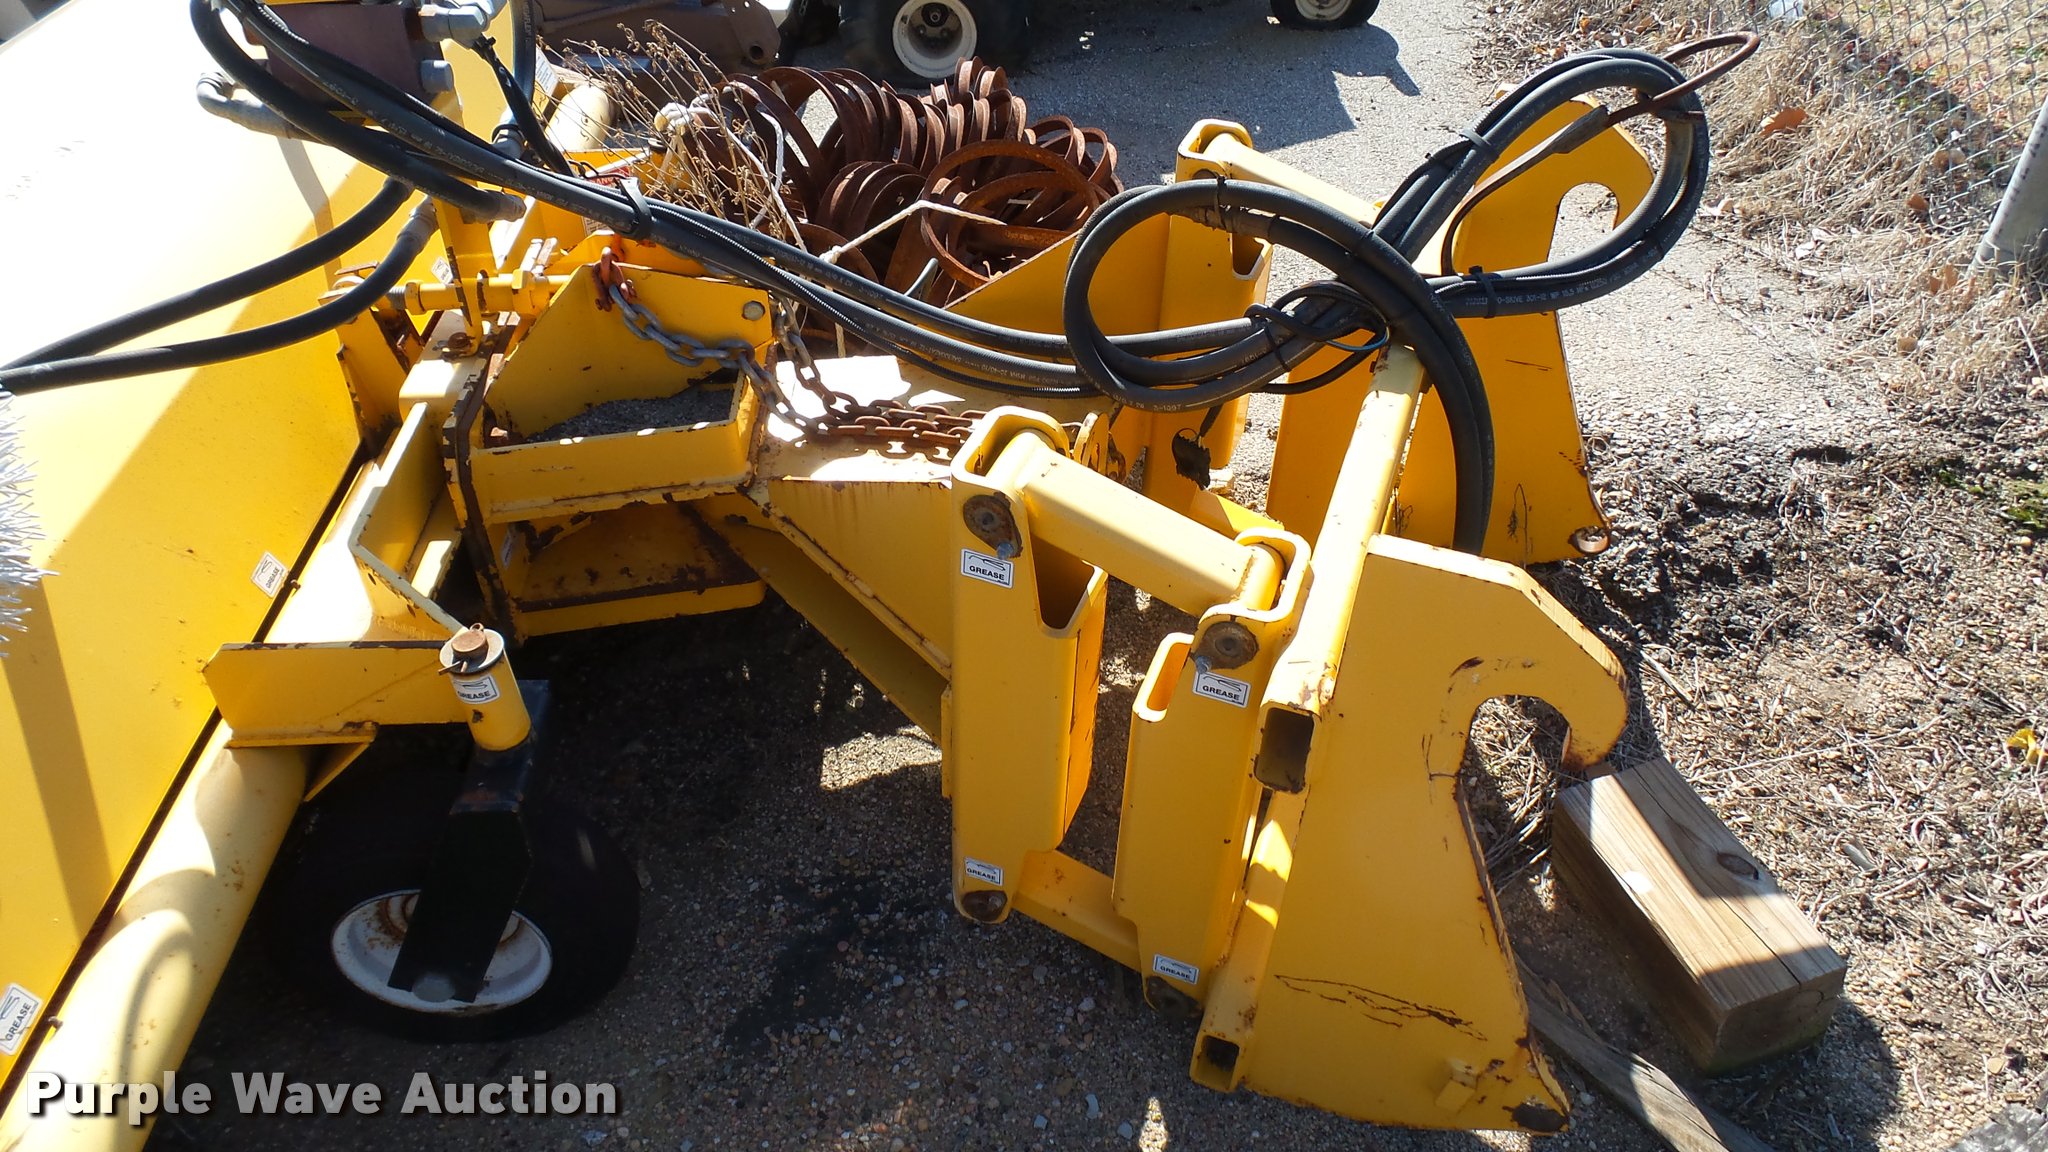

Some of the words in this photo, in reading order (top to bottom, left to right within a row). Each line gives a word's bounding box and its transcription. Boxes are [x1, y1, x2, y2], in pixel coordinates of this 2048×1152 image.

[969, 565, 1005, 581] GREASE
[1202, 685, 1240, 701] GREASE
[966, 867, 996, 881] GREASE
[1160, 965, 1191, 979] GREASE
[4, 1002, 32, 1041] GREASE
